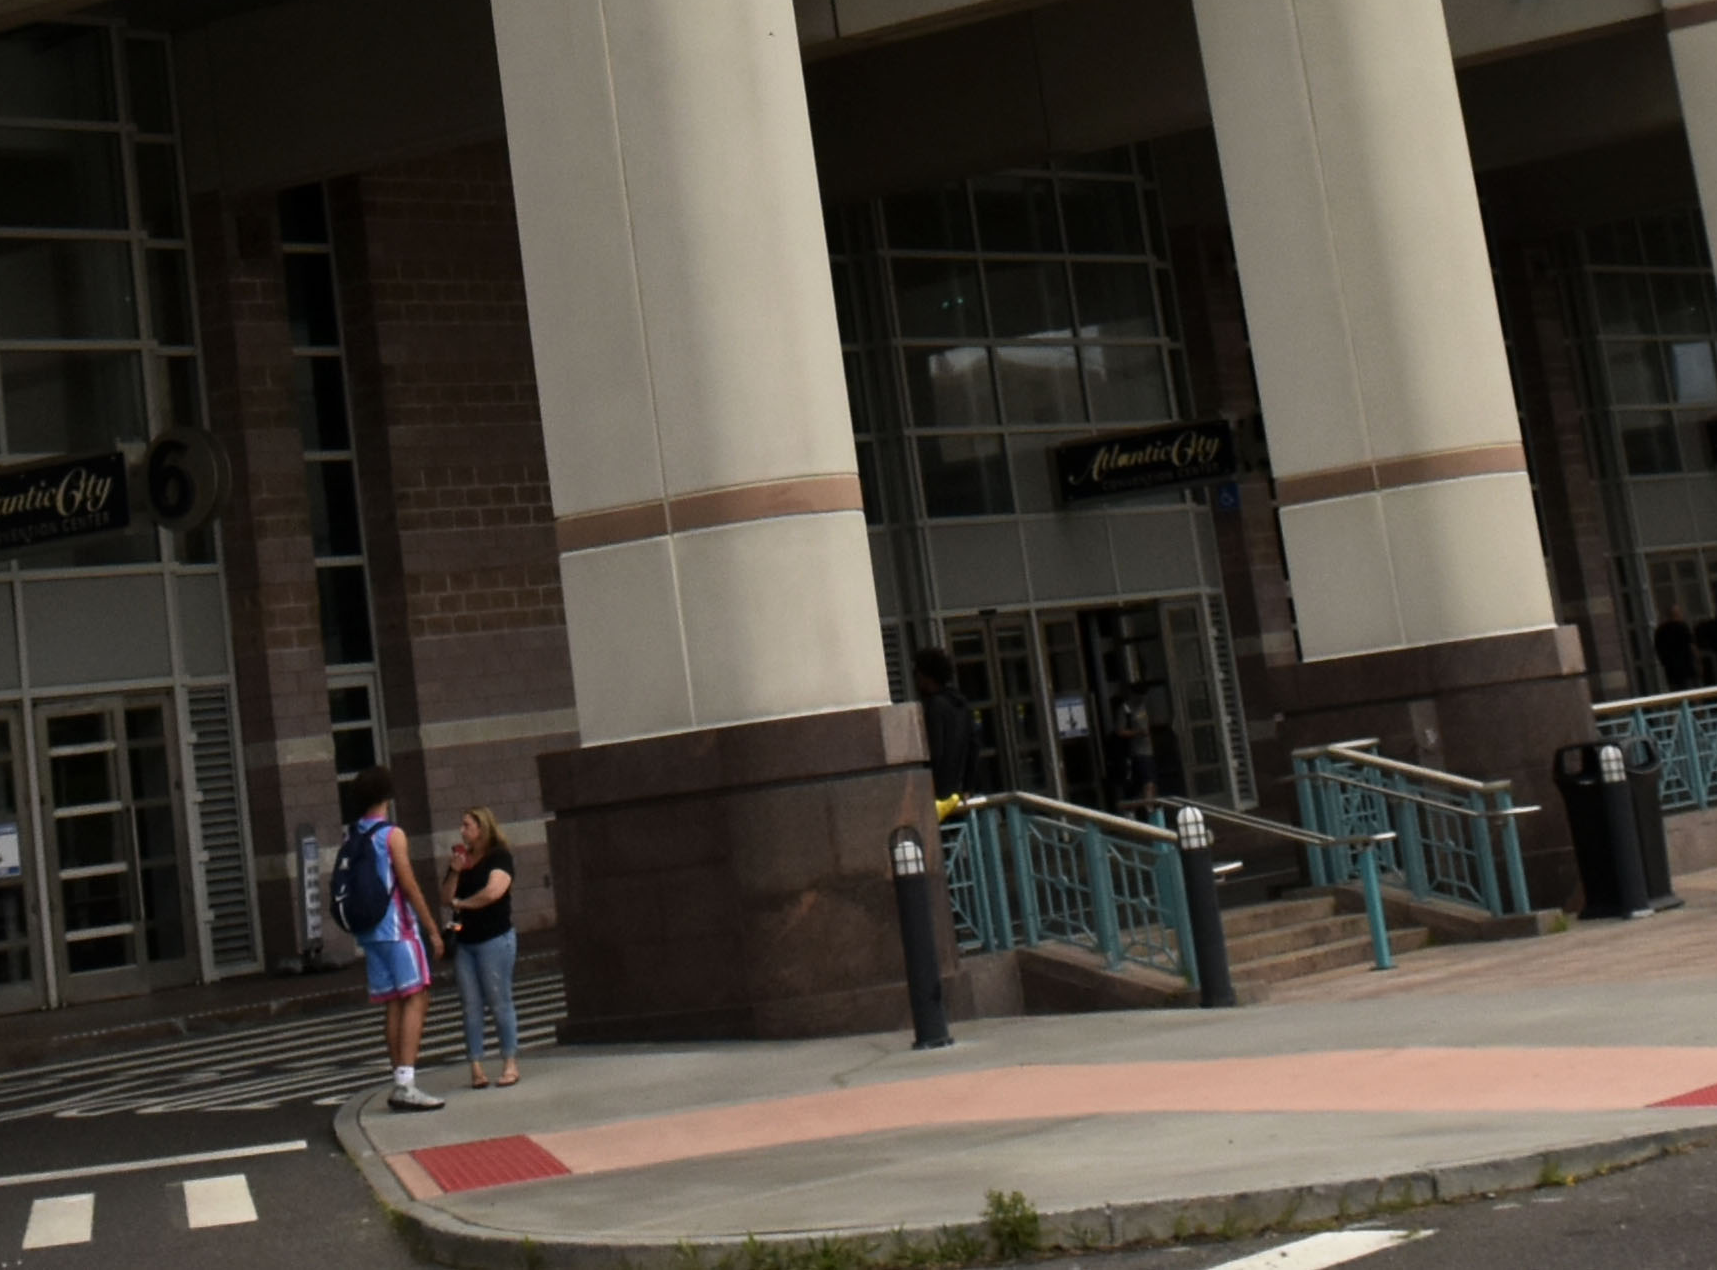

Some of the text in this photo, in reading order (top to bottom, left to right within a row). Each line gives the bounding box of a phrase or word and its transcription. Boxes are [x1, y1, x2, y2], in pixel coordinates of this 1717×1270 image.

[149, 439, 195, 519] 6
[1068, 430, 1223, 486] Atlantic City
[54, 465, 114, 518] City
[61, 510, 111, 533] CENTER
